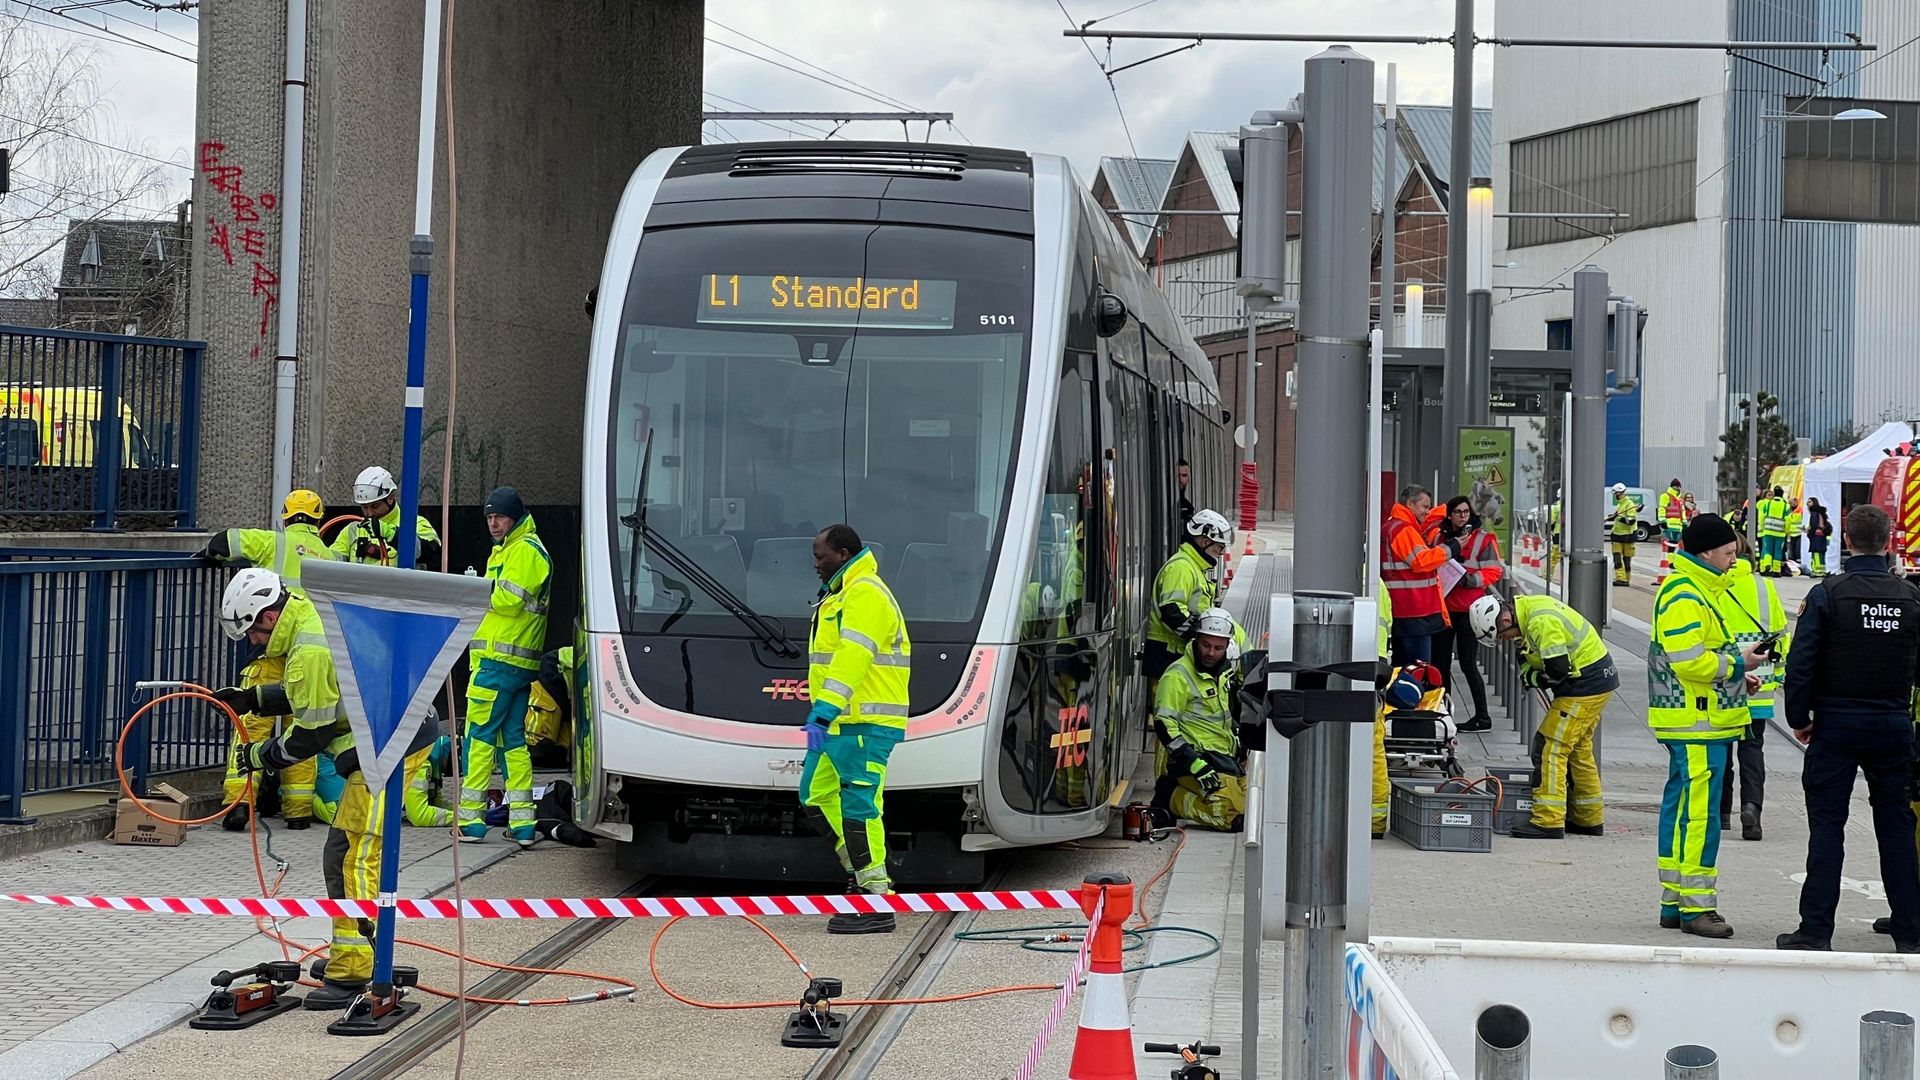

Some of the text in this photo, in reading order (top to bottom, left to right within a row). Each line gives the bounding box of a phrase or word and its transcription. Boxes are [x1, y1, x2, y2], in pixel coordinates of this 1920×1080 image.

[710, 274, 919, 310] L1 Standard
[980, 314, 1016, 325] 5101
[1861, 603, 1902, 617] Police
[1863, 616, 1900, 633] Liege
[770, 679, 811, 701] TEC
[1055, 704, 1089, 769] TEC
[130, 835, 162, 844] Baxter
